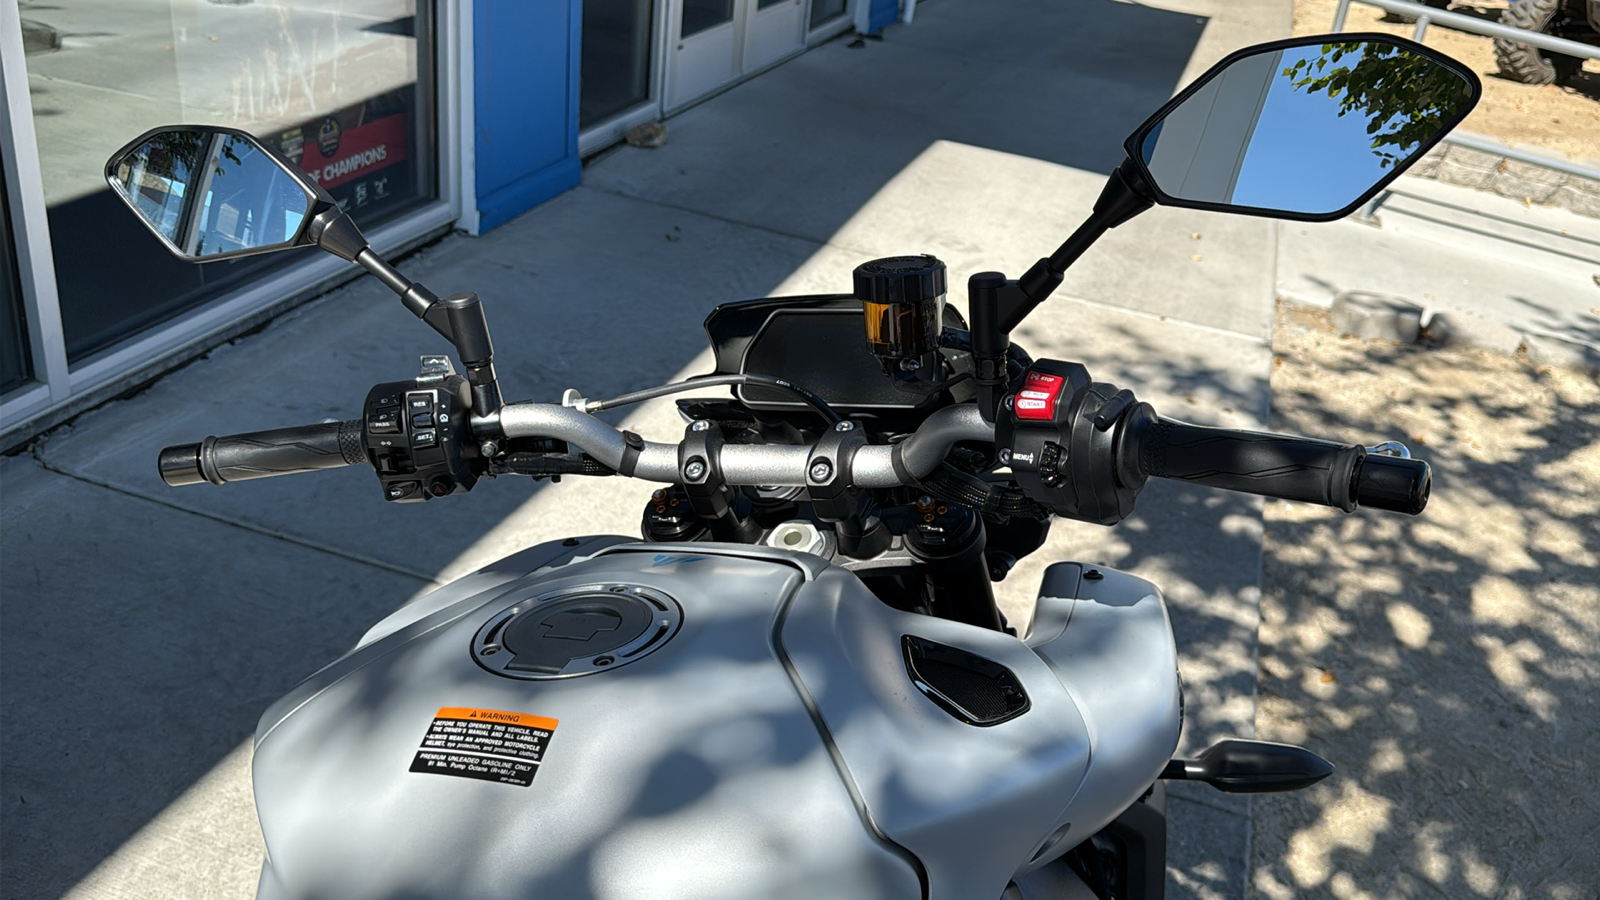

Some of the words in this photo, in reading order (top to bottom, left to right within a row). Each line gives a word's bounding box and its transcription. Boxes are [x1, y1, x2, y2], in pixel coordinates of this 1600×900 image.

[323, 144, 387, 181] CHAMPIONS
[1013, 452, 1030, 461] MENU
[480, 711, 520, 722] WARNING
[467, 728, 489, 737] MANUAL
[468, 722, 492, 730] OPERATE
[532, 730, 549, 738] READ
[474, 737, 503, 746] APPROVED
[503, 741, 541, 752] MOTORCYCLE
[420, 752, 447, 761] PREMIUM
[447, 754, 480, 765] UNLEADED
[481, 758, 513, 770] GASOLINE
[514, 763, 532, 772] ONLY
[449, 761, 467, 771] Pump
[467, 764, 488, 773] Octane
[490, 766, 517, 777] (R+M)/2
